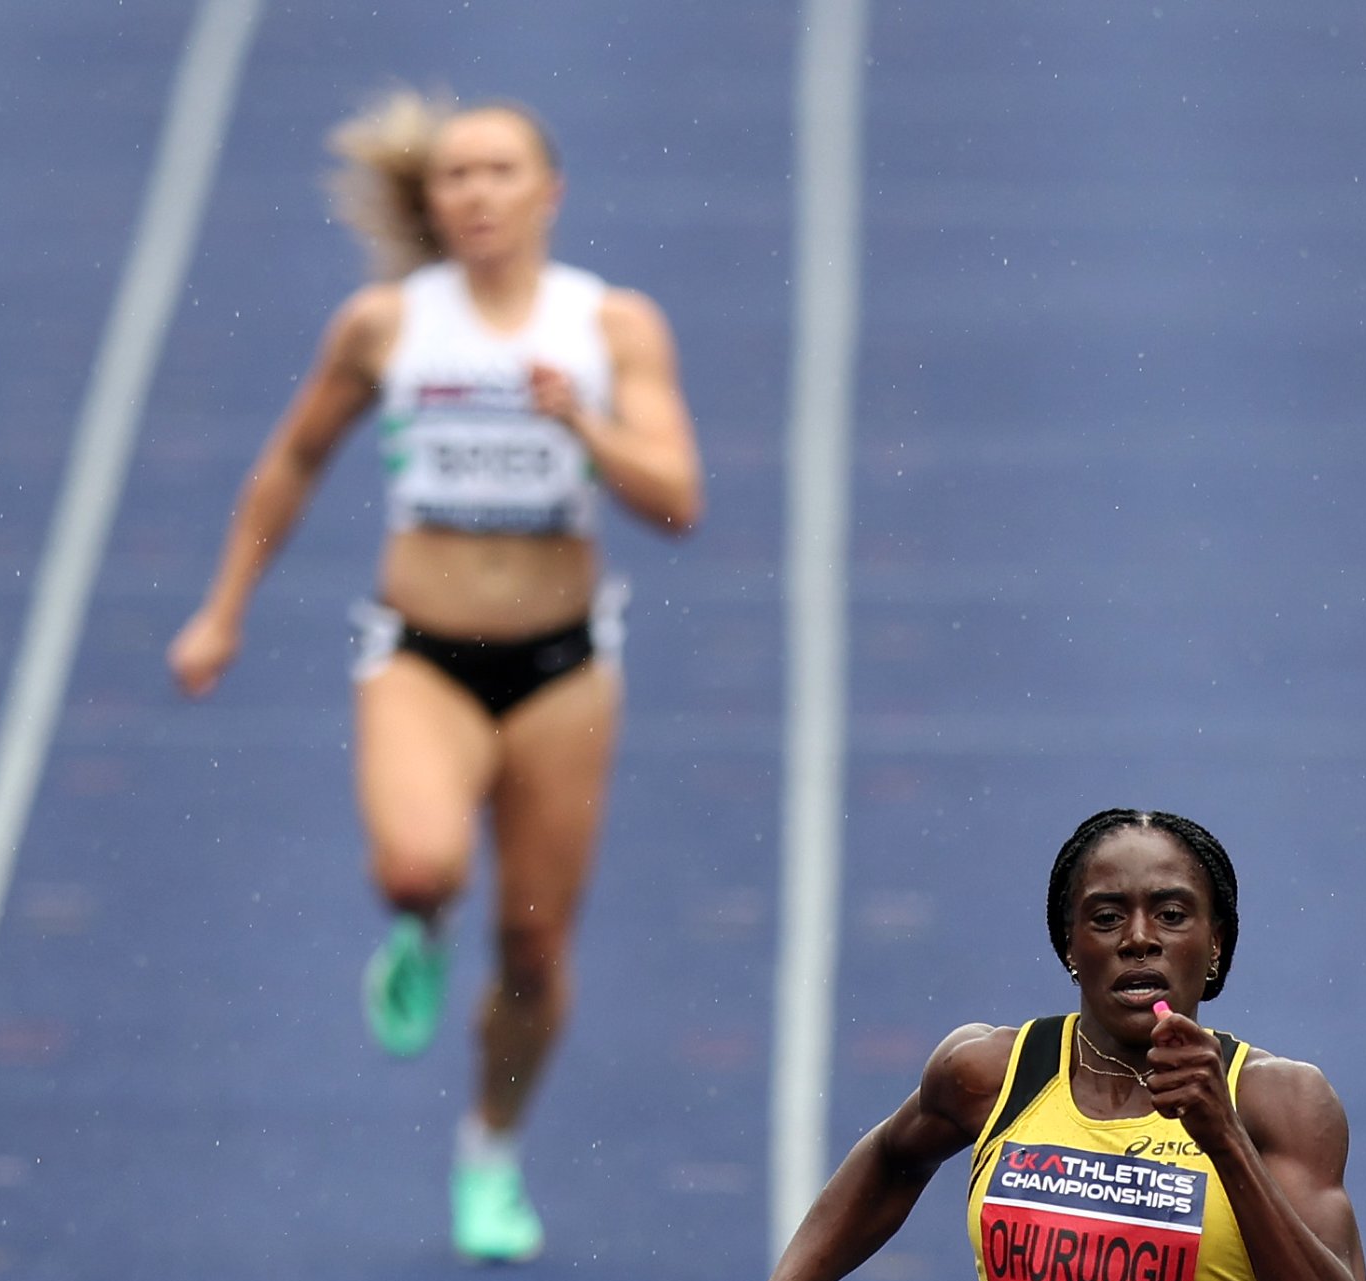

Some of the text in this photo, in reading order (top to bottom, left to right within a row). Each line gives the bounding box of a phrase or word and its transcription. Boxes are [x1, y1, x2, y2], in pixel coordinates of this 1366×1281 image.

[1001, 1171, 1192, 1214] CHAMPIONSHIPS
[1007, 1150, 1197, 1196] UK ATHLETICS
